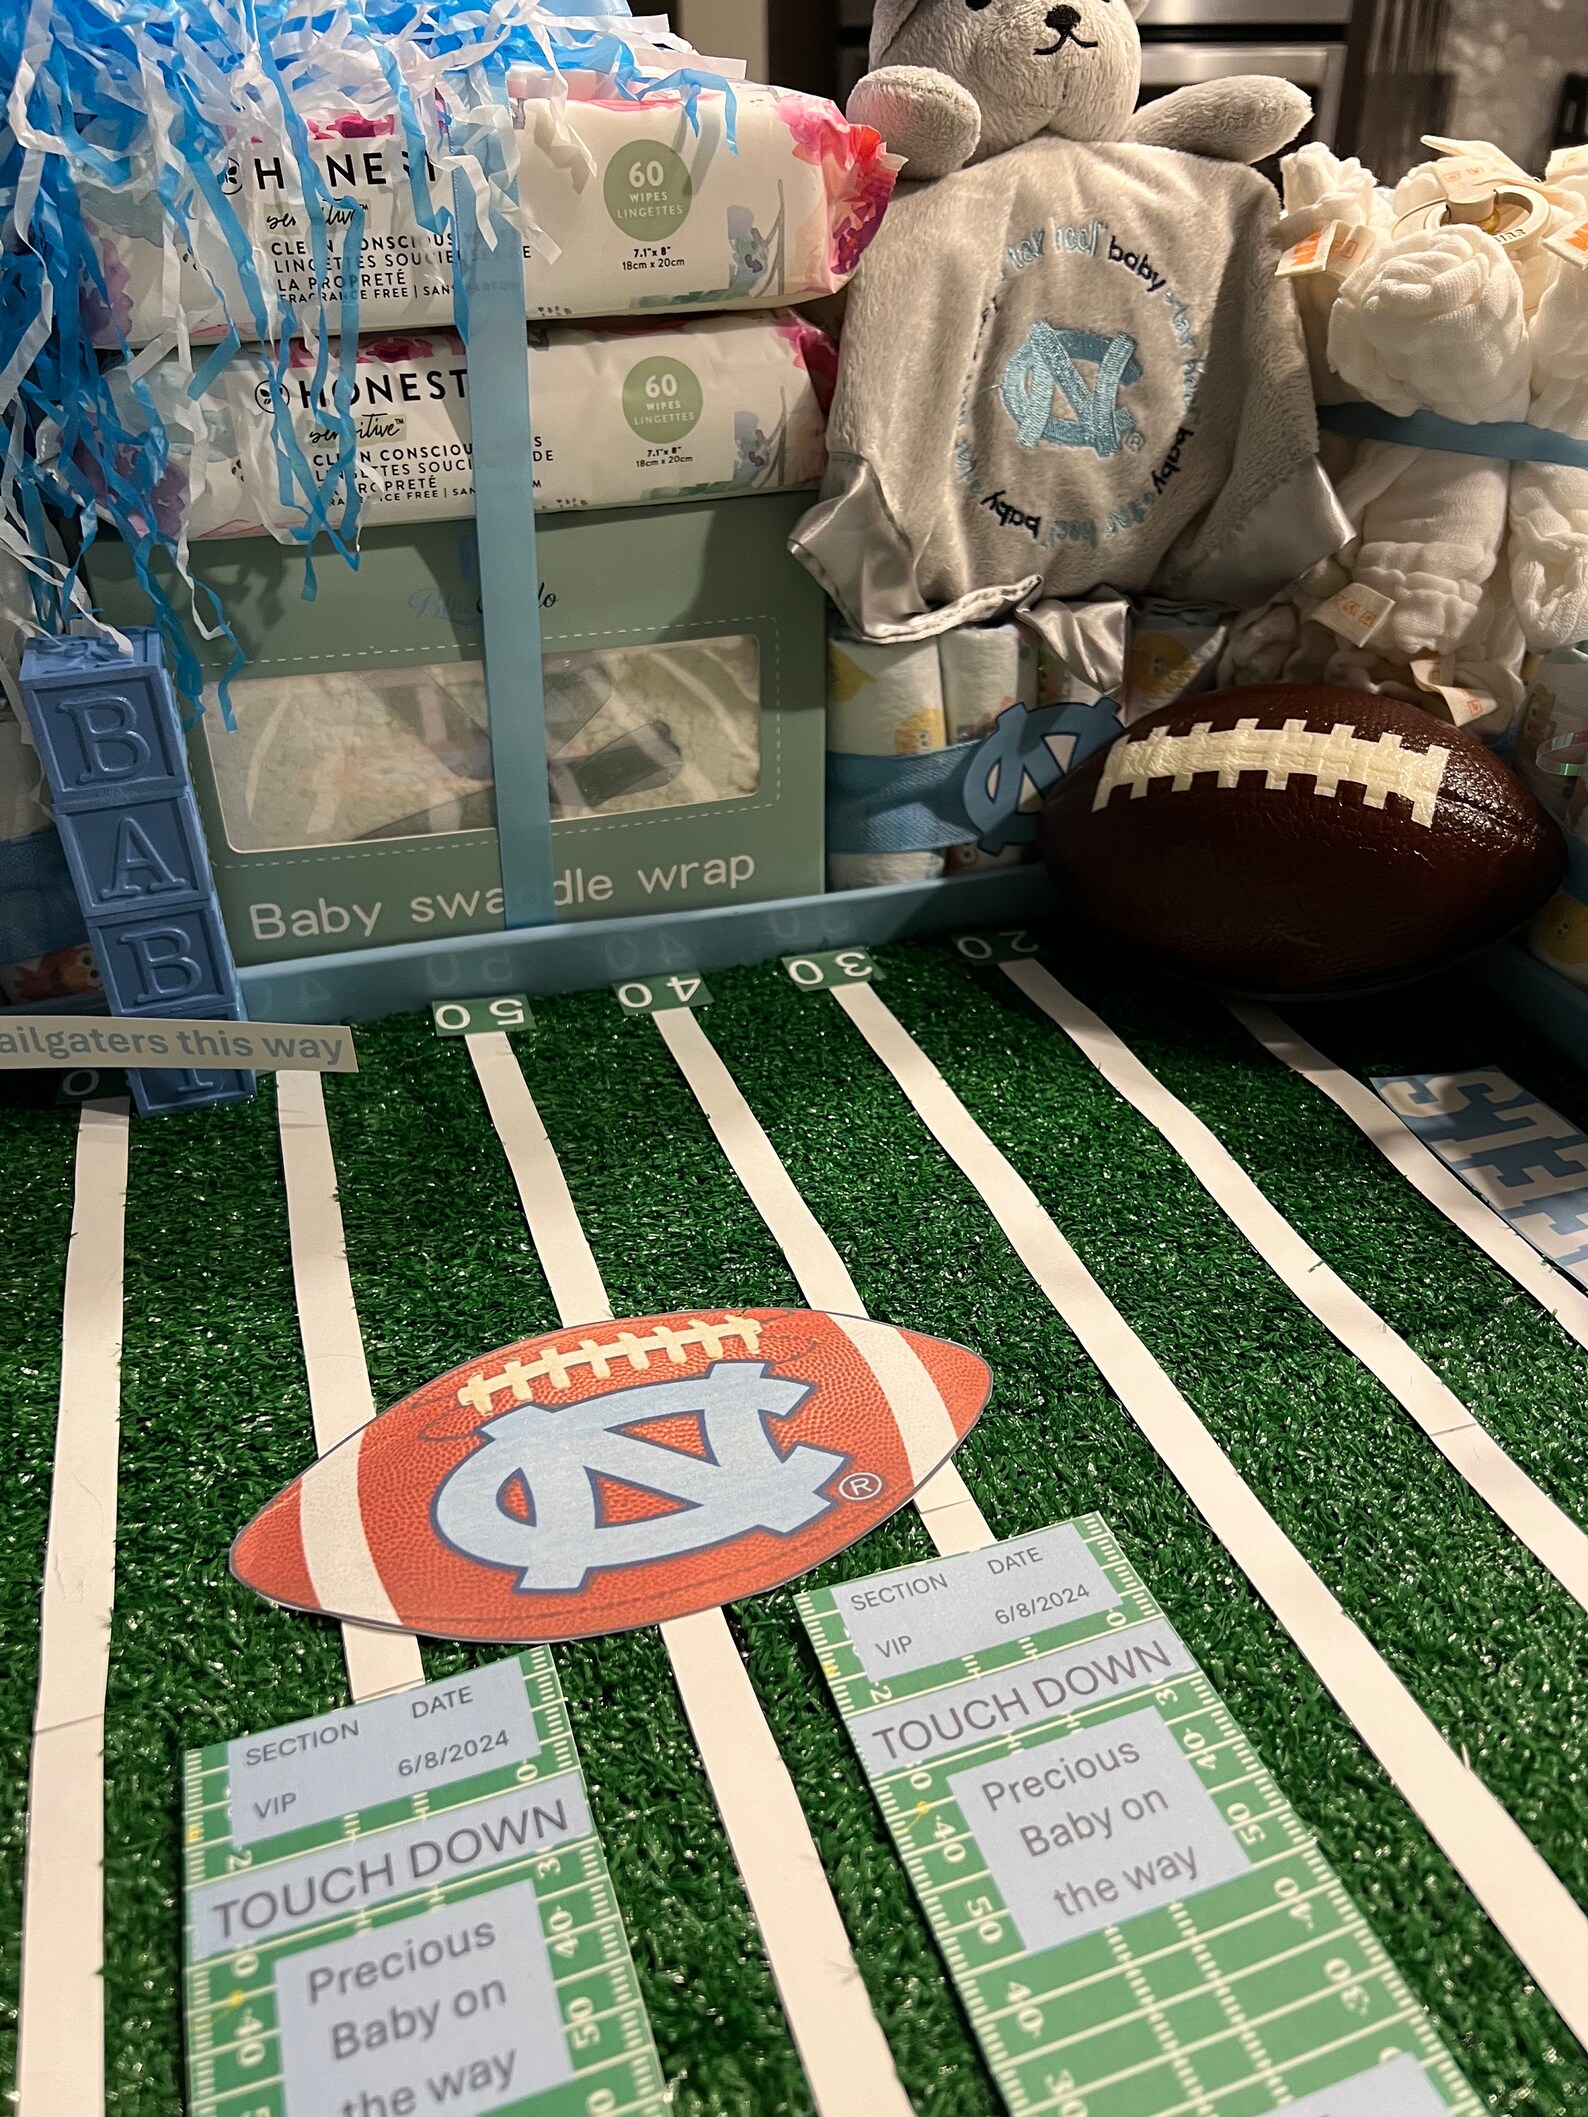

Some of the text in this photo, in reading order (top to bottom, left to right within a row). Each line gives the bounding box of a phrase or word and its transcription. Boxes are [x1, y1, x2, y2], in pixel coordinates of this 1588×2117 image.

[629, 160, 664, 188] 60
[617, 205, 683, 219] LINGETTES
[629, 192, 668, 203] WIPES
[271, 233, 453, 255] CLEN ONSCIUS
[622, 261, 647, 271] 18cm
[658, 258, 685, 268] 20cm
[1107, 235, 1166, 293] baby
[278, 278, 299, 291] LA
[374, 287, 408, 299] FREE
[424, 284, 454, 296] SAN
[645, 373, 678, 398] 60
[634, 411, 695, 426] LINGETTES
[646, 400, 681, 411] WIPES
[313, 443, 473, 466] CLN CONSCIOU
[533, 450, 553, 462] DE
[636, 459, 659, 468] 18cm
[668, 455, 693, 464] 20cm
[1151, 426, 1194, 494] baby
[359, 475, 437, 493] ROPRETÉ
[407, 488, 476, 500] FREE SAN
[981, 490, 1041, 538] baby
[249, 853, 756, 941] Baby swadle wrap
[957, 930, 1040, 961] 20
[787, 951, 874, 987] 30
[618, 975, 702, 1010] 40
[434, 999, 525, 1031] 50
[0, 1026, 342, 1065] ailgaters this way
[62, 1069, 100, 1097] 0
[851, 1547, 1043, 1611] SECTION DATE
[875, 1583, 1090, 1659] VIP 6/8/2024
[872, 1639, 1172, 1761] TOUCH DOWN
[245, 1685, 474, 1767] SECTION DATE
[253, 1728, 510, 1820] VIP 6/8/2024
[981, 1741, 1141, 1812] Precious
[1019, 1788, 1169, 1858] Baby on
[212, 1799, 569, 1938] TOUCH DOWN
[1053, 1845, 1199, 1918] the way
[307, 1920, 496, 2006] Precious
[331, 1979, 507, 2060] Baby on
[426, 2049, 517, 2100] way
